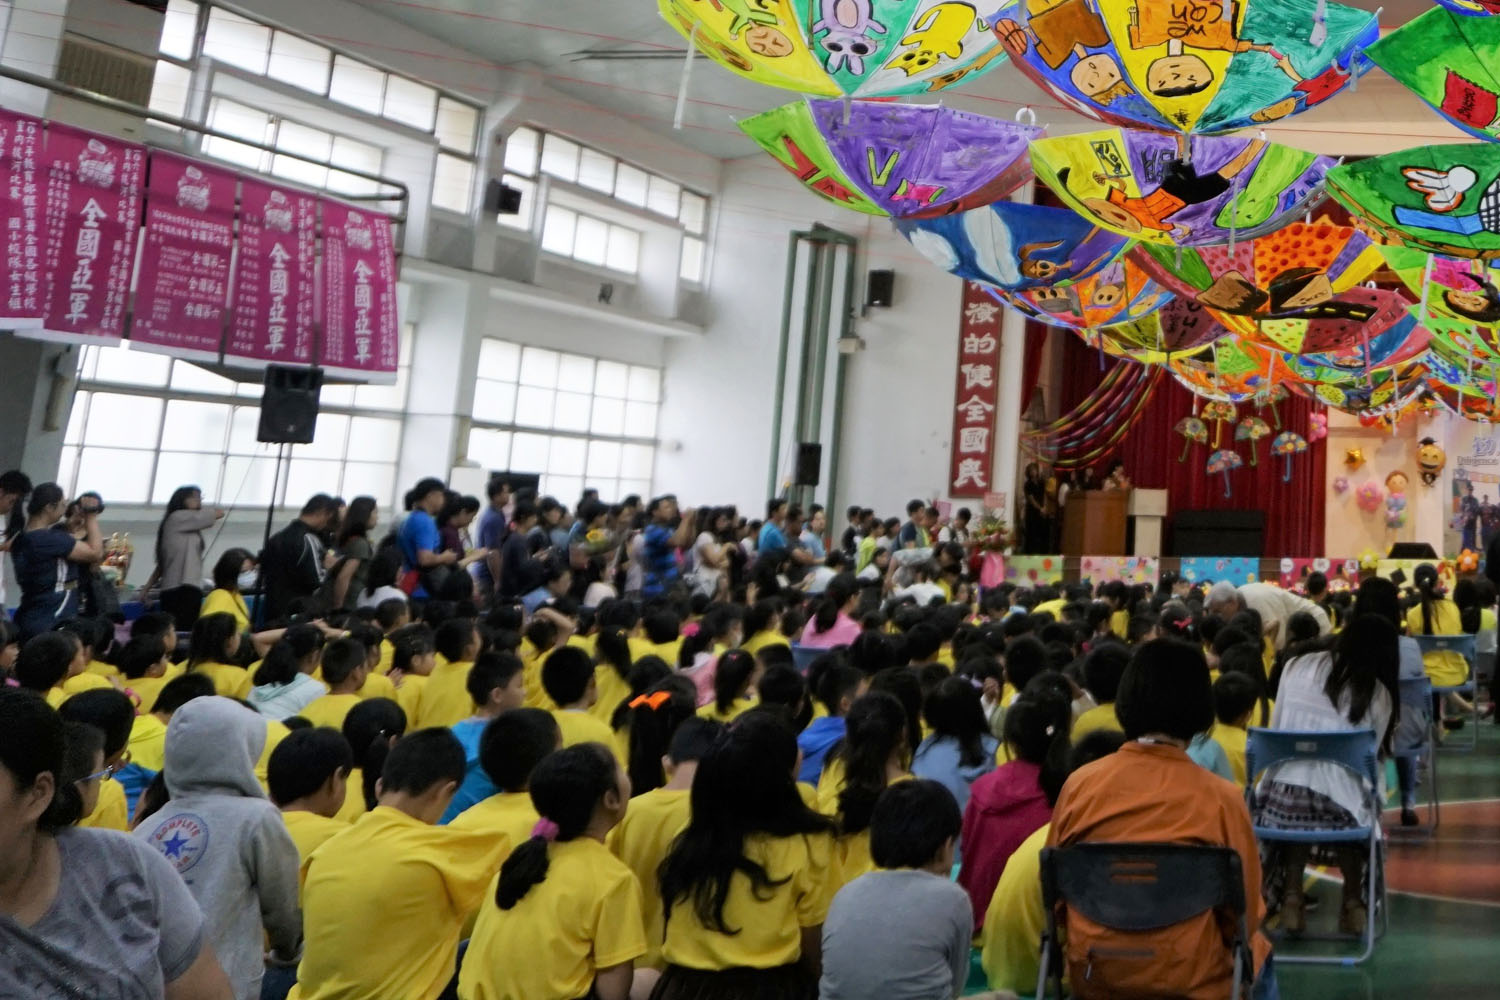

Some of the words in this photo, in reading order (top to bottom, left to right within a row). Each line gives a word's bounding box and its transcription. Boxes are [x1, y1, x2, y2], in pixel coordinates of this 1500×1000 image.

[64, 198, 107, 325] 全國亞軍
[264, 242, 291, 355] 全國亞軍
[353, 259, 375, 365] 全國亞軍
[1457, 456, 1499, 467] Diligence
